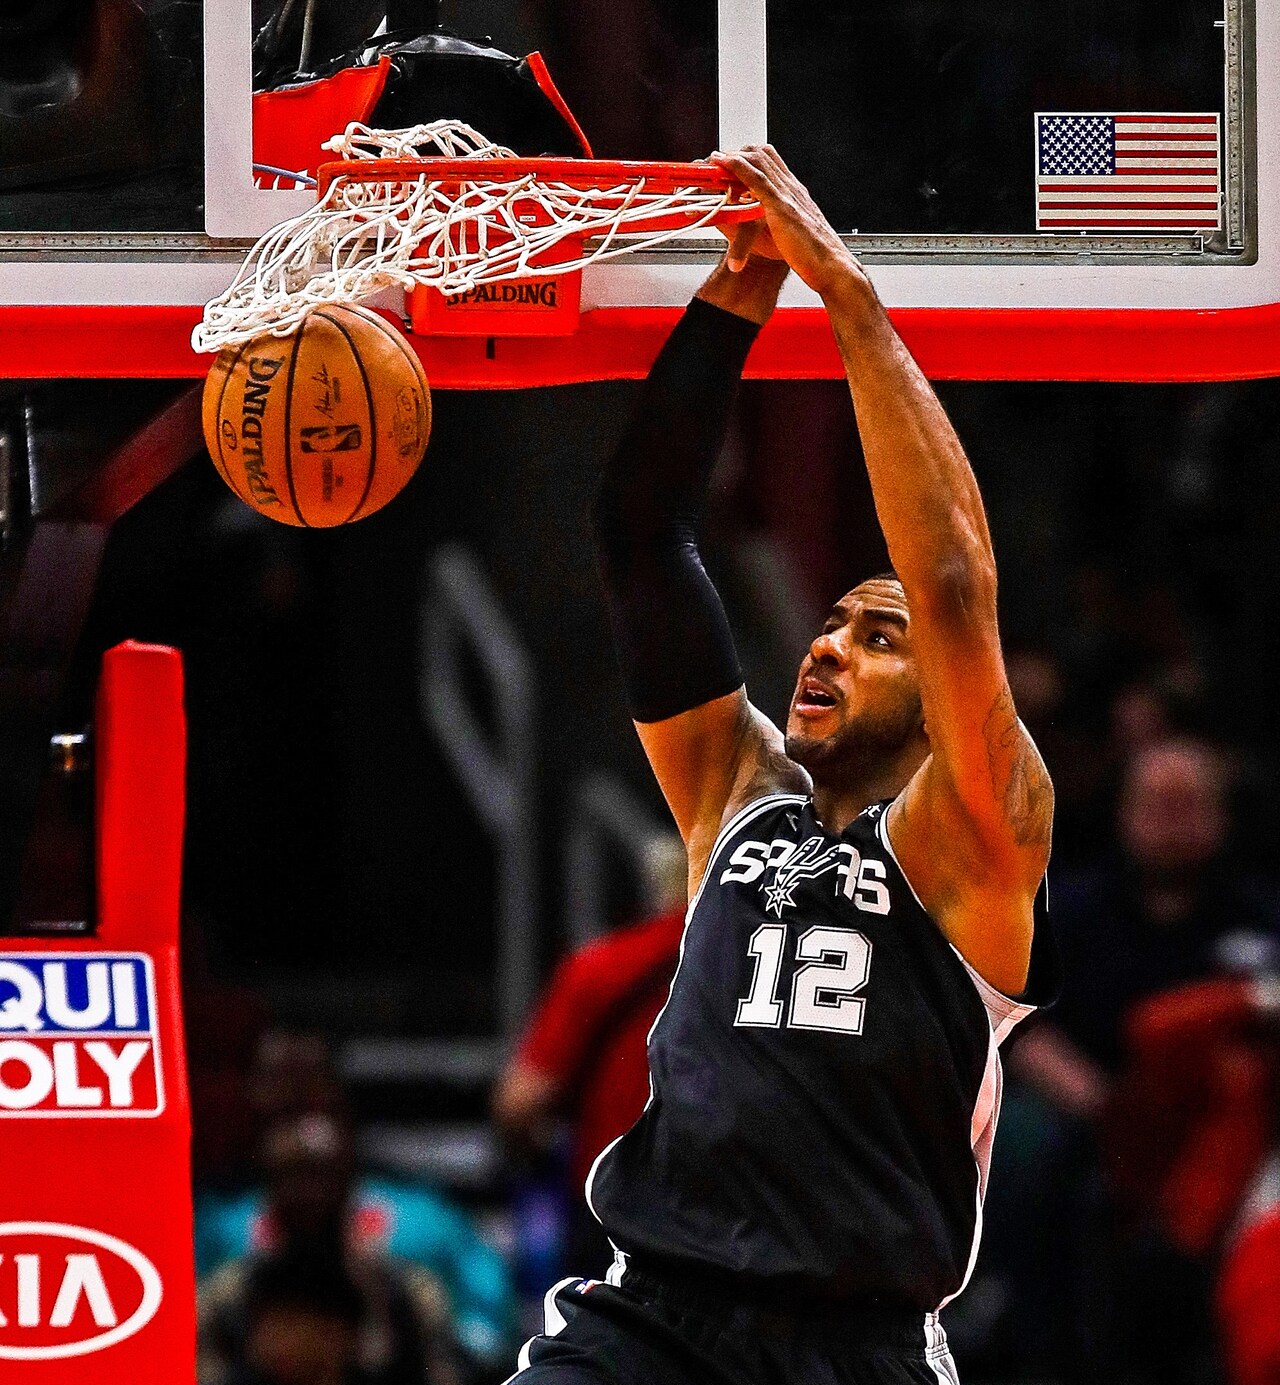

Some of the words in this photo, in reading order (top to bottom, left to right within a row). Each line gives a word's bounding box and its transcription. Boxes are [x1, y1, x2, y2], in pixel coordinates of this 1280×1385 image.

[241, 355, 287, 507] SPALDING
[733, 922, 873, 1036] 12
[0, 1040, 151, 1110] OLY
[0, 1253, 119, 1328] IA
